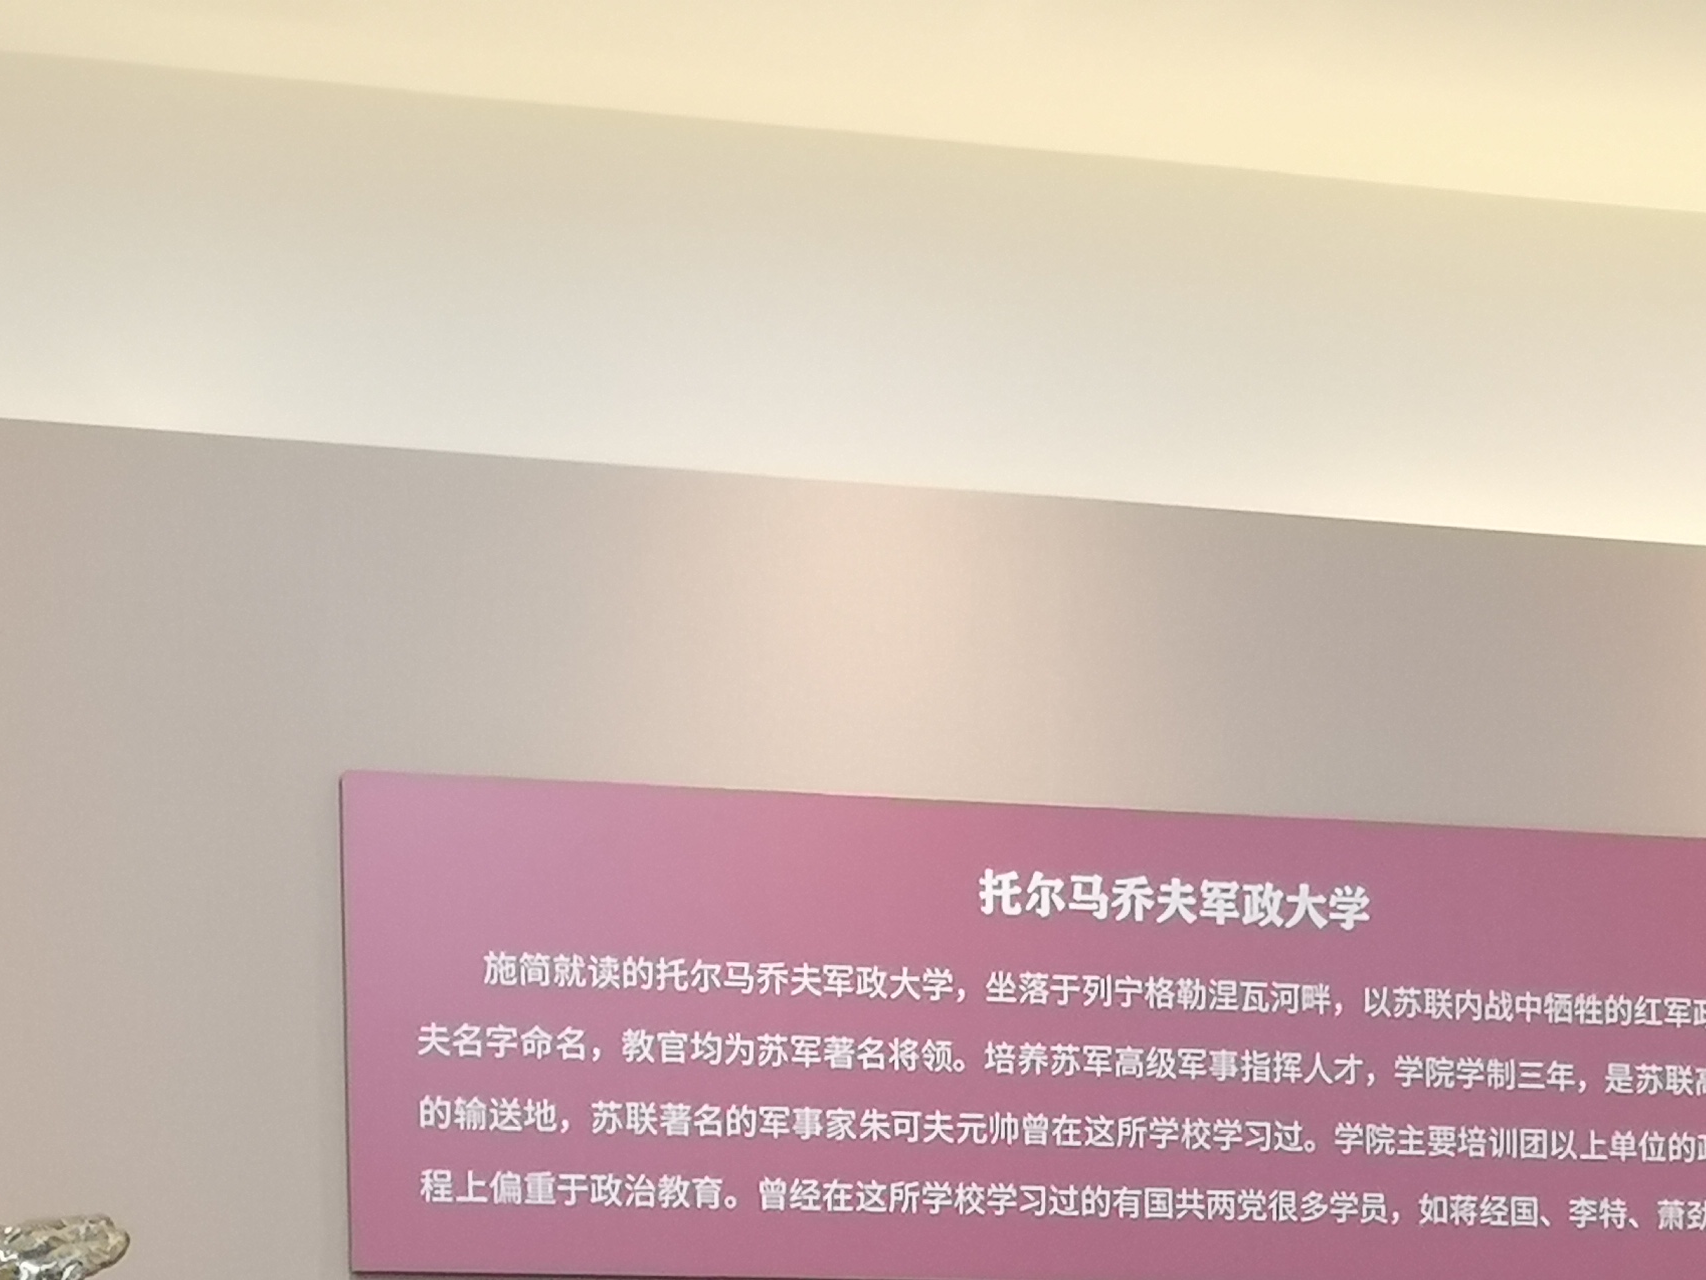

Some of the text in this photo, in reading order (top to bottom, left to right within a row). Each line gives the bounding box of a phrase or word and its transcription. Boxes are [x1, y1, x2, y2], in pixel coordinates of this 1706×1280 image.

[978, 869, 1371, 931] 托尔马乔夫军政大学
